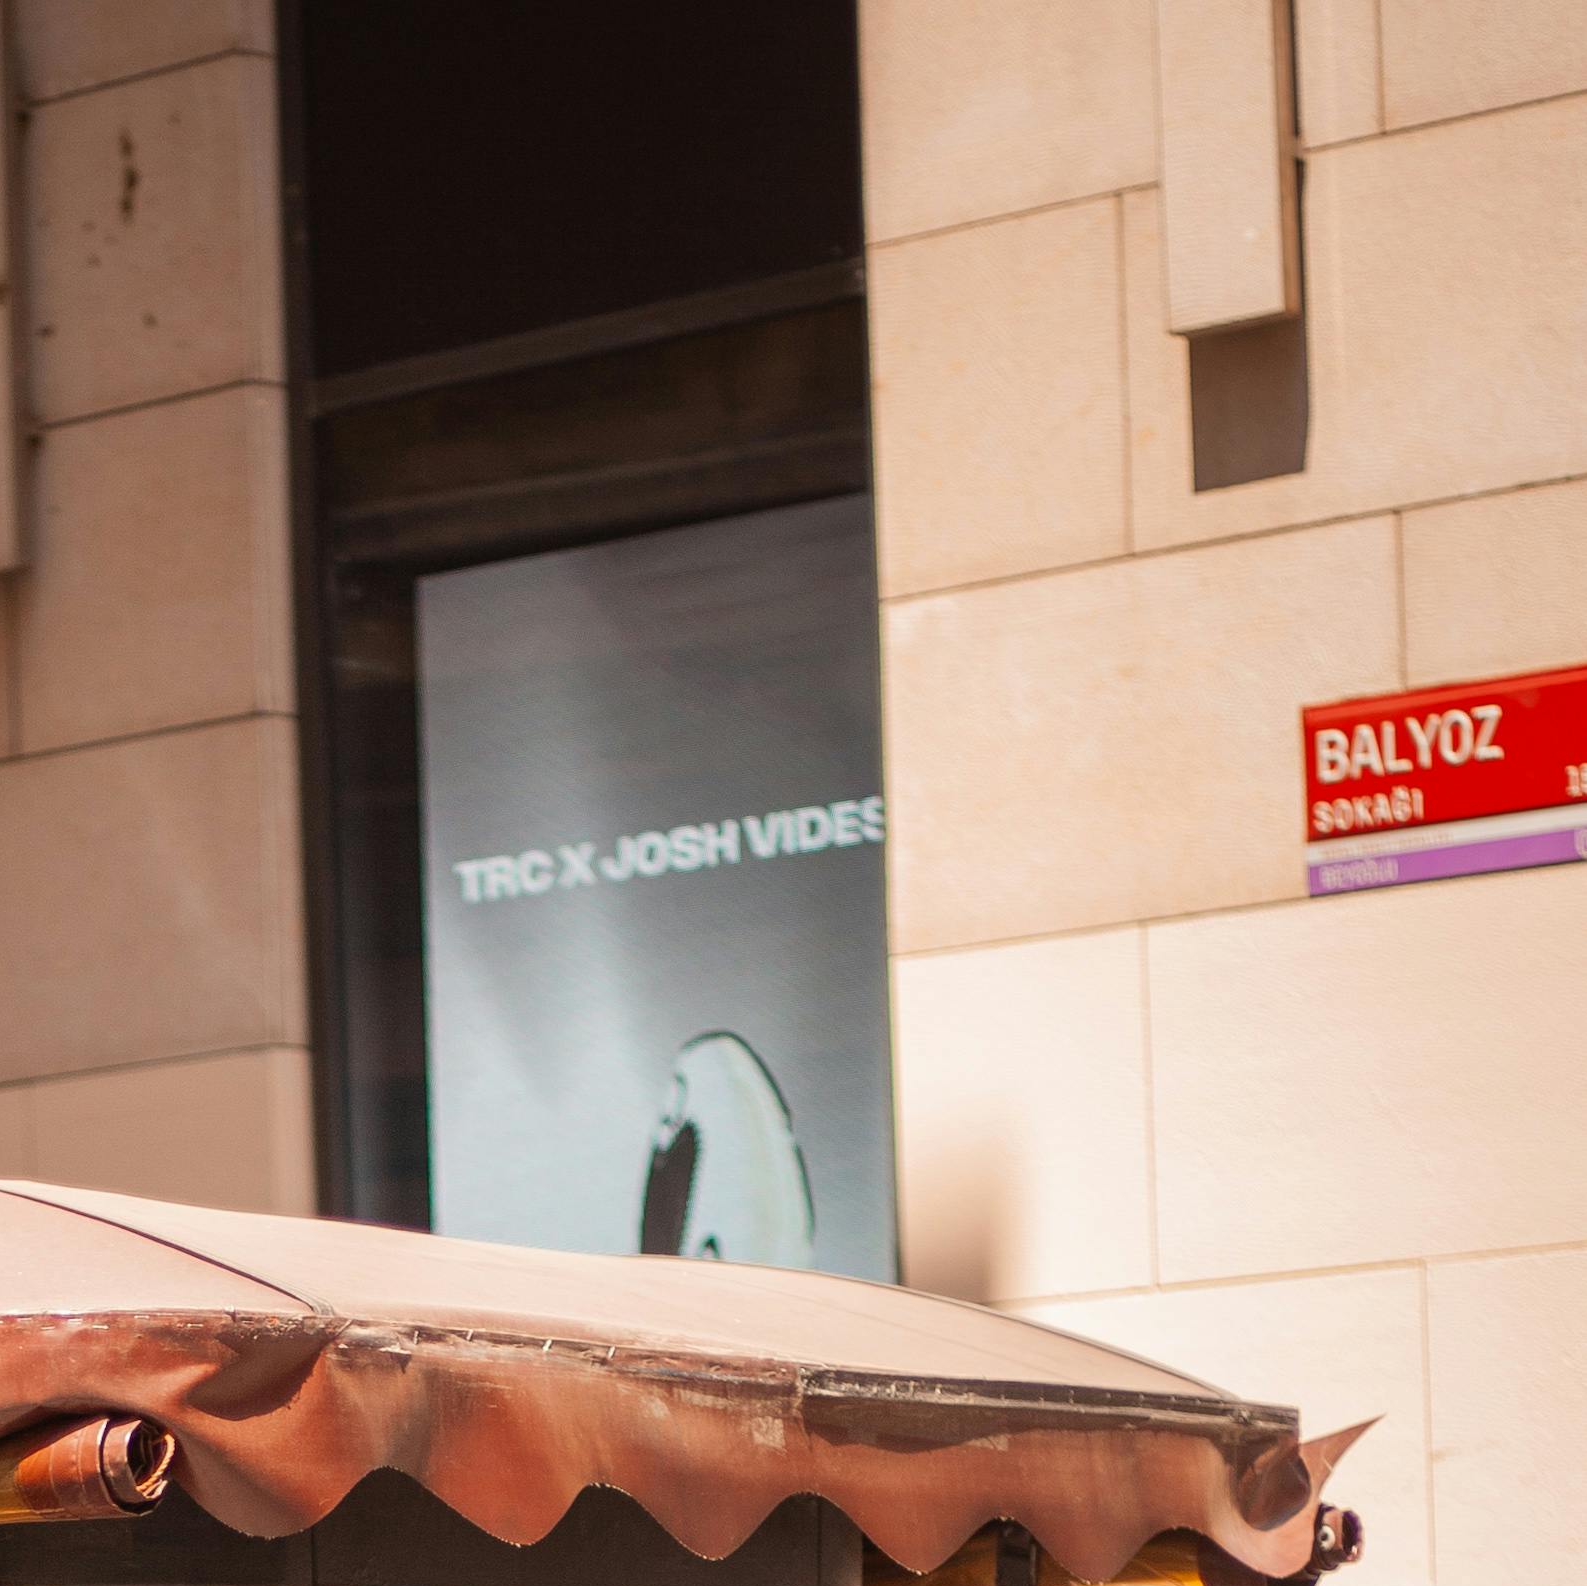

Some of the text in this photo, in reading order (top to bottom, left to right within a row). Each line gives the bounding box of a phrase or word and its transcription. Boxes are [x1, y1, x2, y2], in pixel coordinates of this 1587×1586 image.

[1315, 704, 1505, 784] BALYOZ
[452, 796, 885, 902] TRC X JOSH VIDES
[1312, 785, 1424, 833] SOKAĞI
